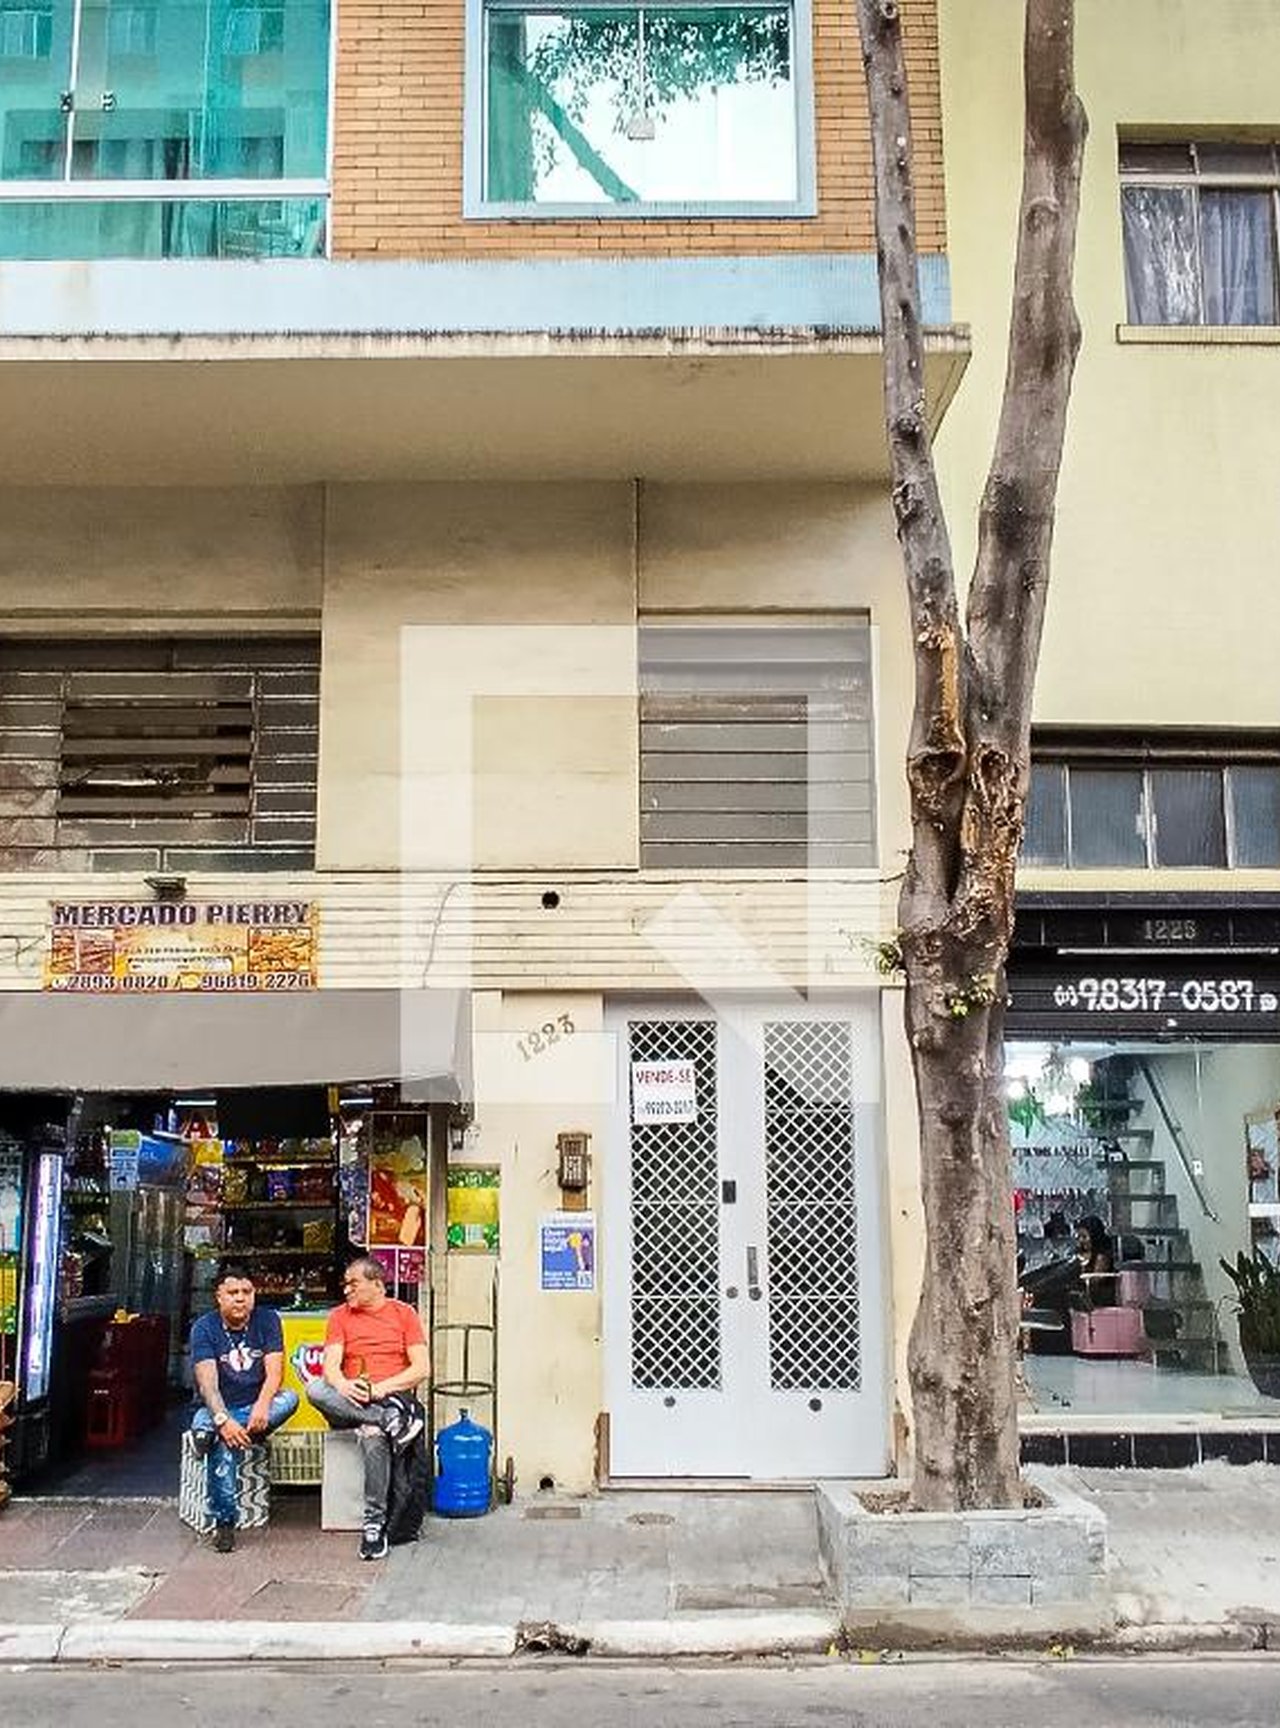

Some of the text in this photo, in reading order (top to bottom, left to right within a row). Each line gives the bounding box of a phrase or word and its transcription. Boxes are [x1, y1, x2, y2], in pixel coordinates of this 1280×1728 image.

[54, 902, 309, 926] MERCADO PIERRY
[516, 1014, 575, 1062] 1223
[635, 1068, 692, 1084] VENDE-SE
